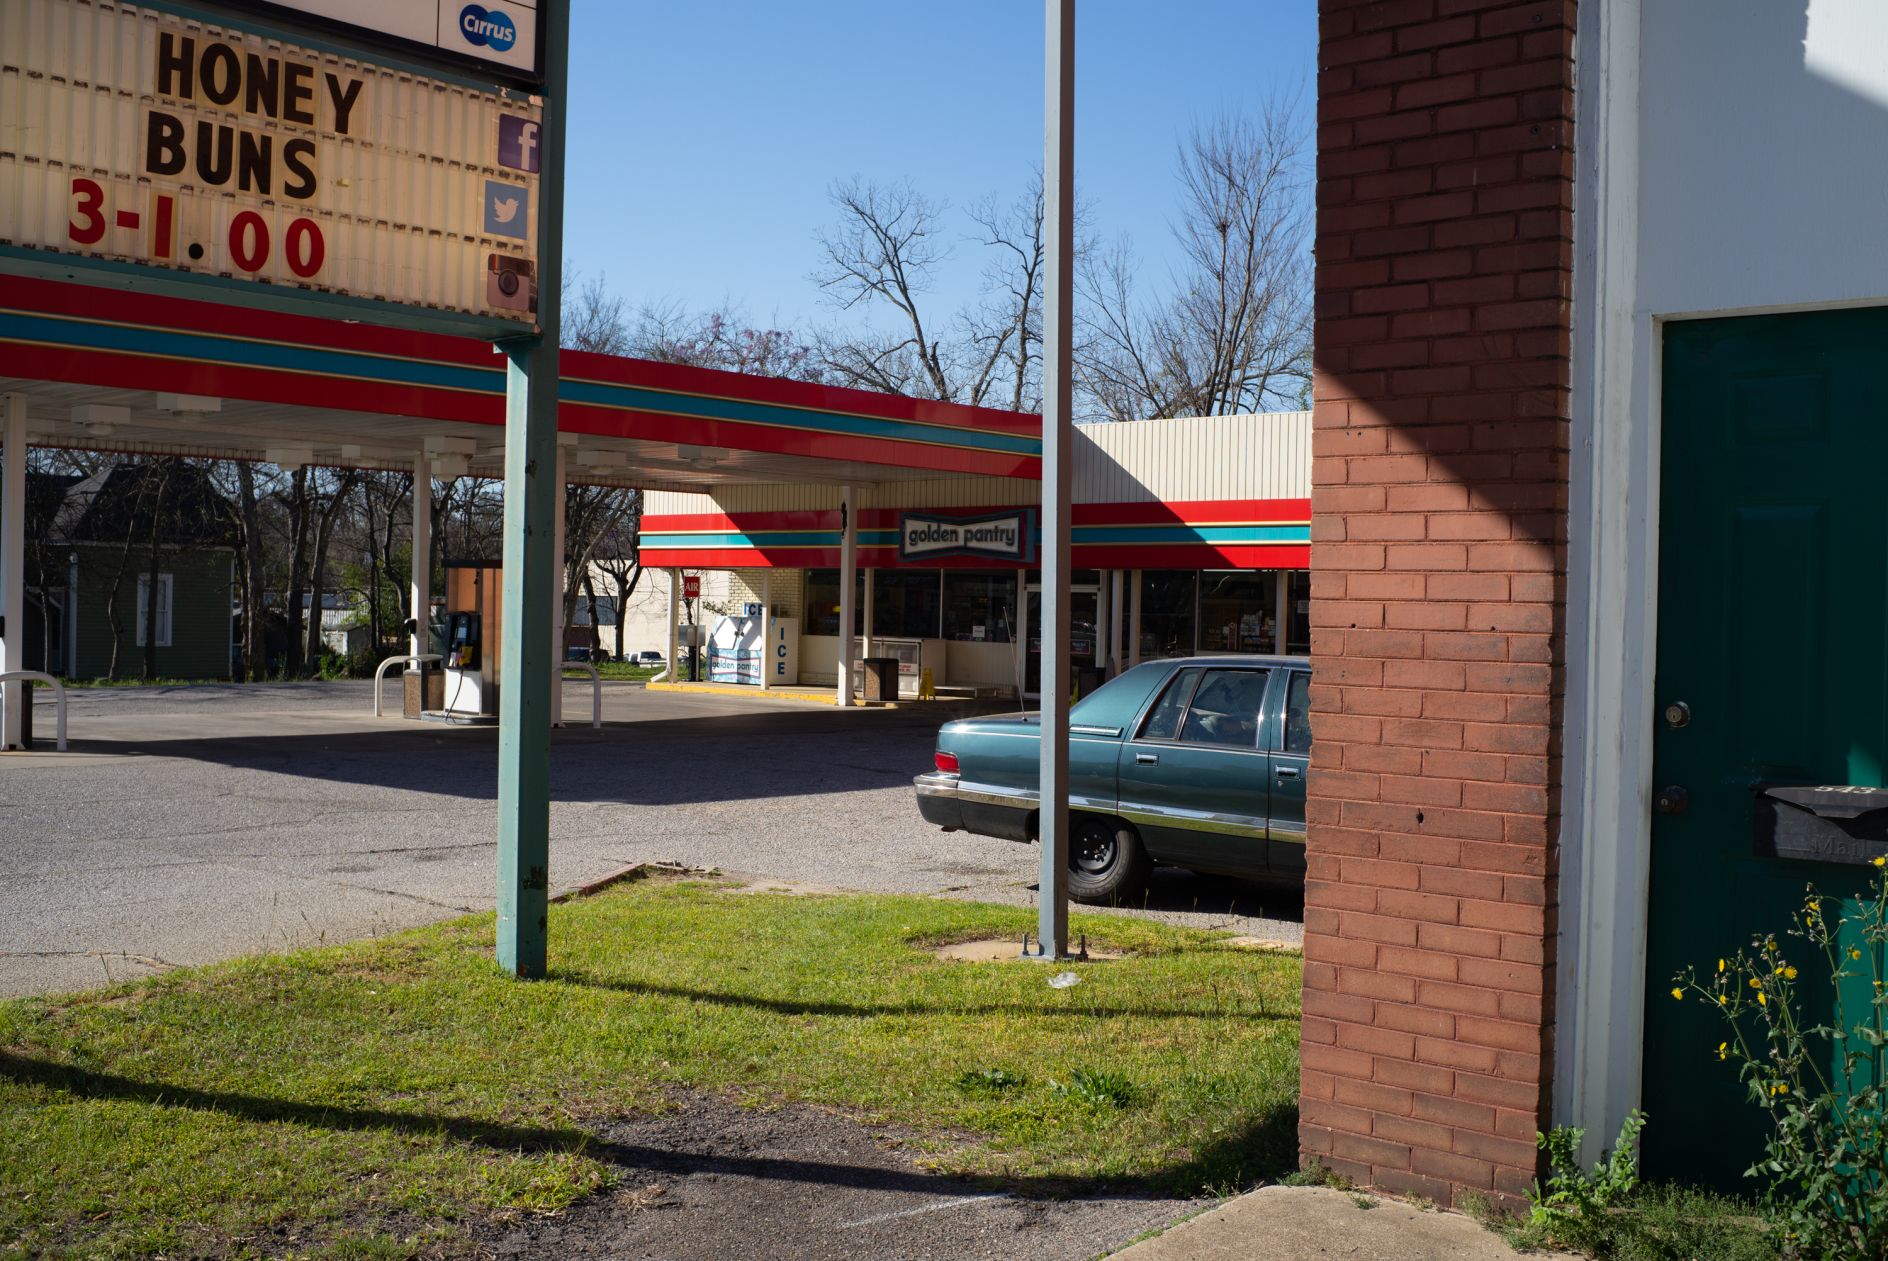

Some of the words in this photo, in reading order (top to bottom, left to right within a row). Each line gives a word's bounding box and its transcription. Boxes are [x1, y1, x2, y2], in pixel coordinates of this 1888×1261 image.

[464, 14, 513, 42] Cirrus
[158, 31, 363, 134] HONEY
[146, 111, 317, 199] BUNS
[909, 523, 958, 546] golden
[964, 526, 1015, 548] pantry
[685, 583, 699, 592] AIR
[777, 627, 787, 675] ICE
[712, 658, 735, 669] golden
[737, 661, 760, 673] pantry
[1808, 834, 1866, 859] Mail
